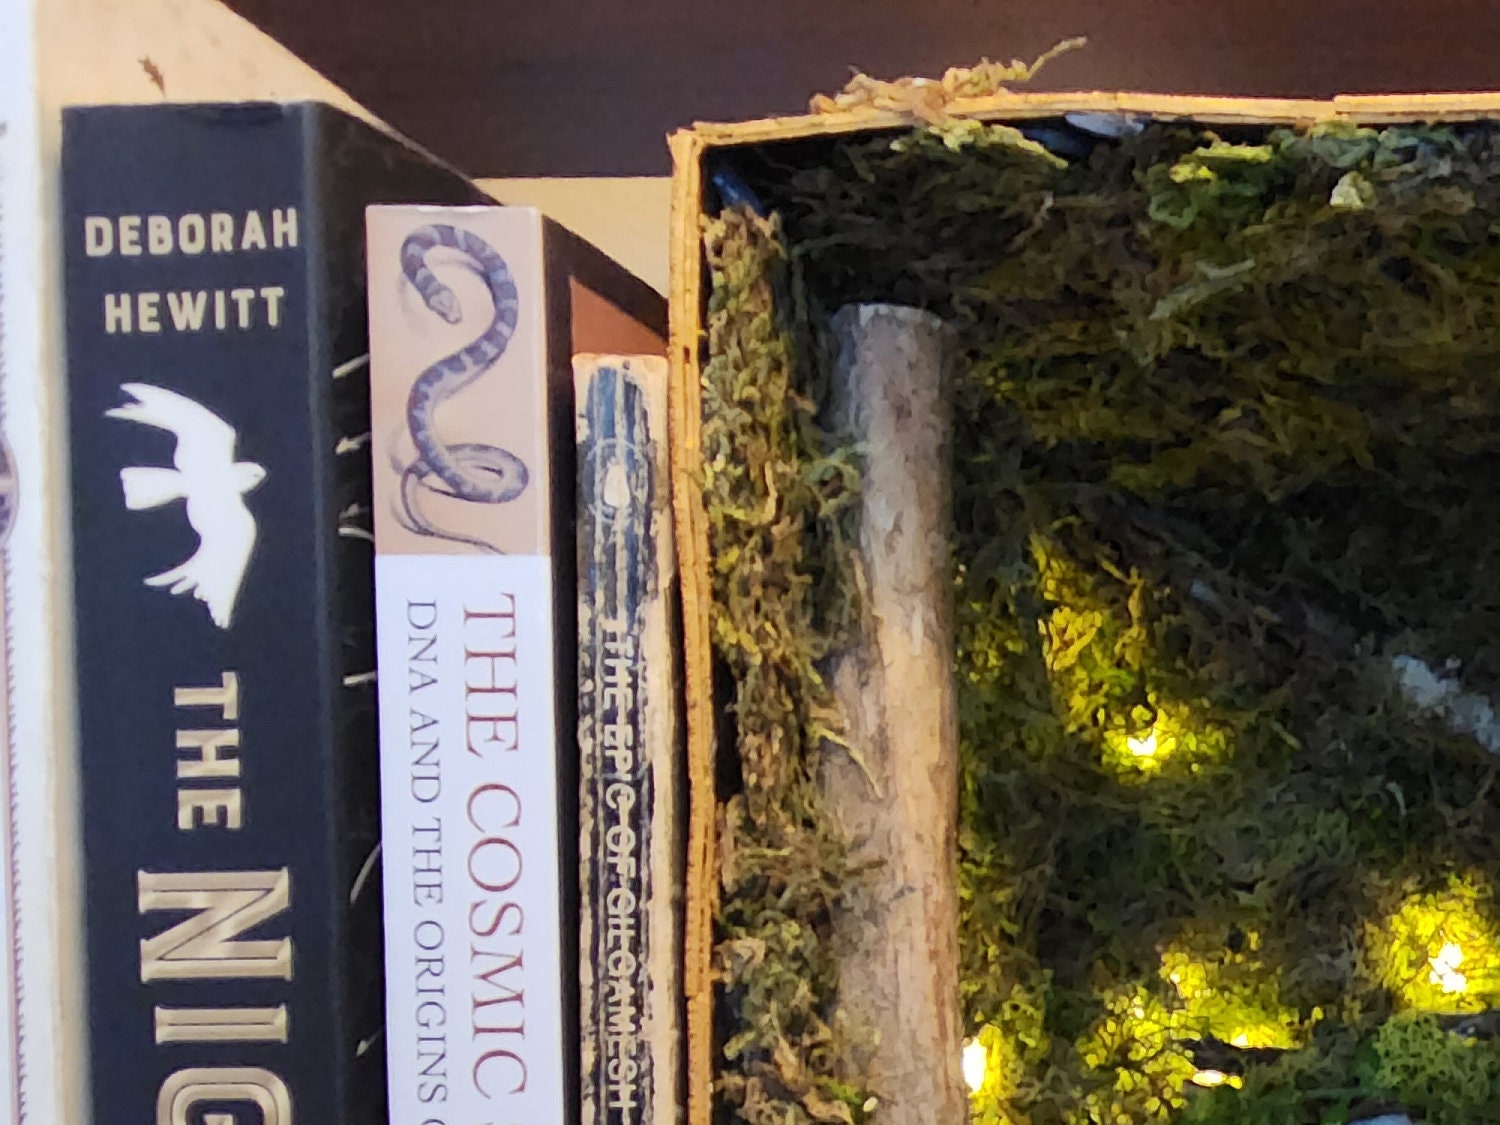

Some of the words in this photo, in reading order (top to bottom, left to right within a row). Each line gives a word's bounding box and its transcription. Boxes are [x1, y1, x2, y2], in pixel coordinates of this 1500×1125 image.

[85, 208, 298, 256] DEBORAH
[104, 287, 285, 333] HEWITT
[407, 600, 439, 694] DNA
[463, 593, 520, 758] THE
[603, 635, 634, 709] THE
[174, 671, 241, 830] THE
[409, 708, 441, 804] AND
[603, 723, 635, 810] EPIC
[411, 817, 444, 905] THE
[606, 825, 636, 879] OF
[465, 783, 529, 1099] COSMIC
[413, 921, 450, 1105] ORIGINS
[605, 887, 637, 1109] GILGAMESH
